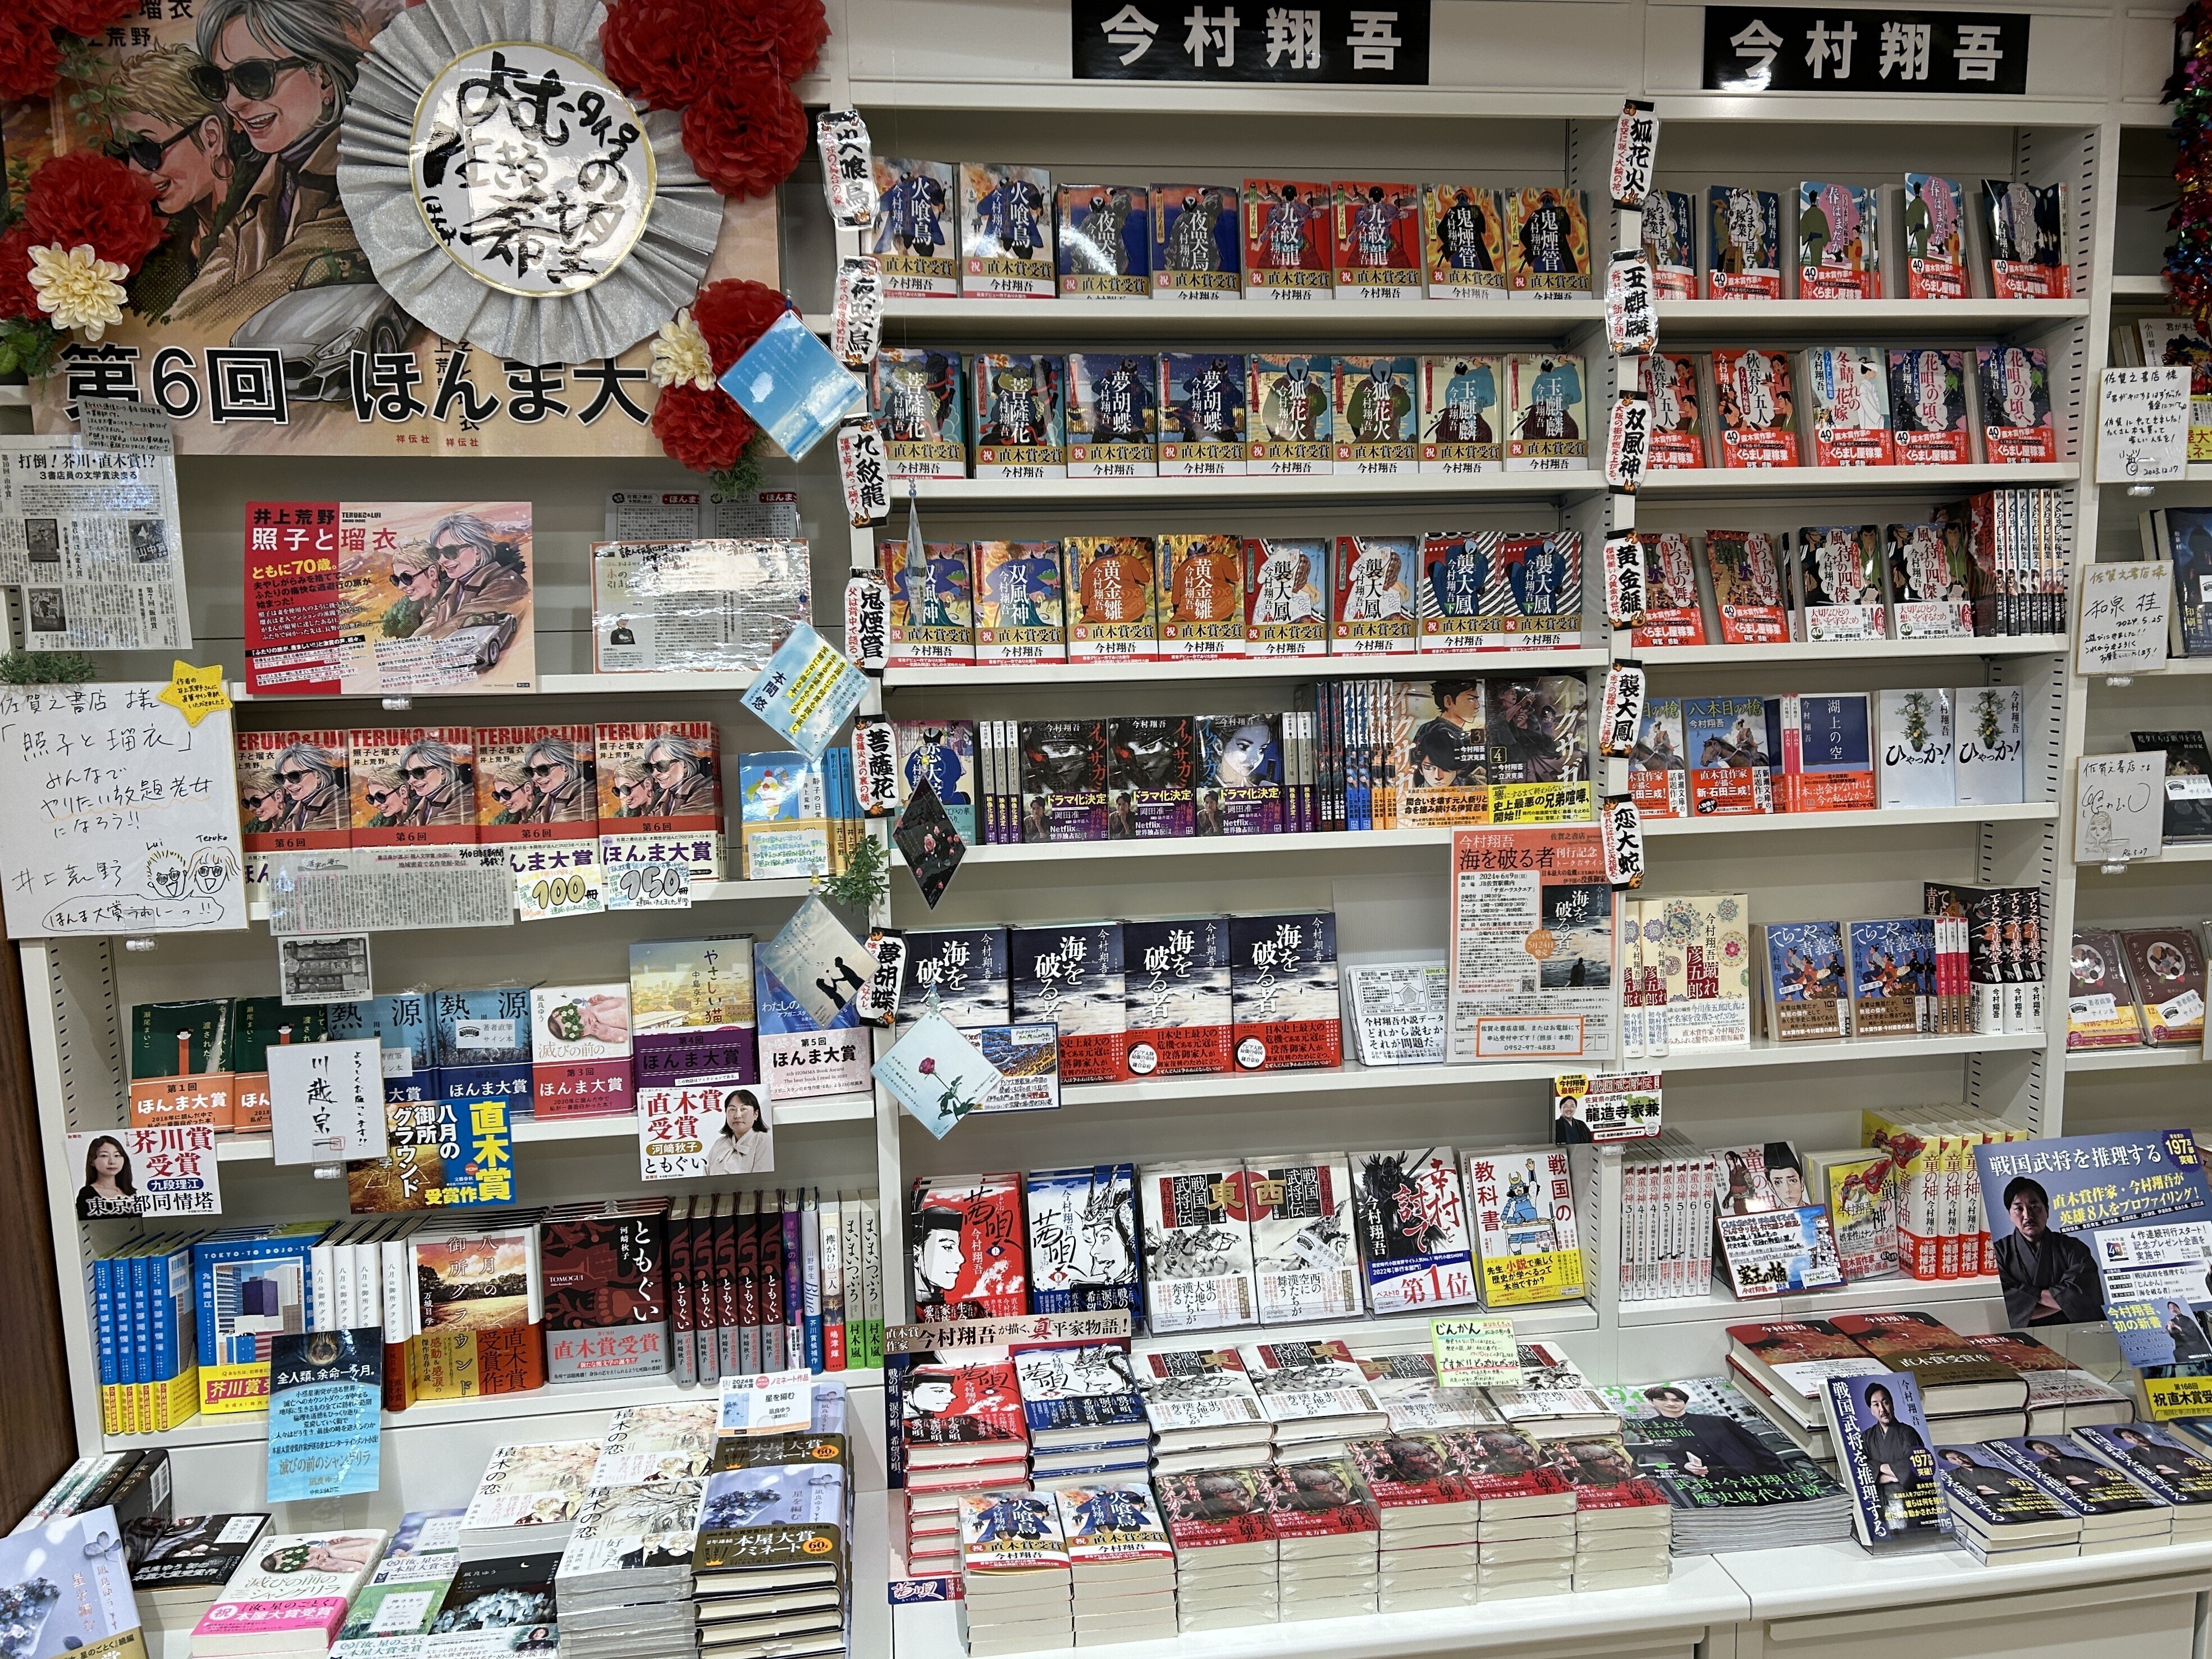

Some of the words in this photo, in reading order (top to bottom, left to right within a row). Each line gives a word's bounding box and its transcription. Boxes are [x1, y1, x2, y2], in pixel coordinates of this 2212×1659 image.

[1100, 4, 1402, 71] 今村翔吾
[1730, 19, 2003, 81] 今村翔吾
[1623, 118, 1653, 193] 狐花火
[911, 177, 931, 246] 火喰鳥
[1011, 181, 1030, 248] 火喰鳥
[1826, 185, 1844, 253] 春はまだか
[1280, 203, 1300, 266] 九紋龍
[1457, 207, 1477, 268] 鬼煙管
[987, 260, 1052, 279] 直木賞受賞
[990, 279, 1034, 292] 今村翔吾
[1358, 270, 1419, 285] 直木賞受賞
[1623, 267, 1651, 338] 玉麒麟
[58, 342, 289, 426] 第6回
[349, 349, 651, 427] ほんま大
[1745, 353, 1771, 424] 秋暮の五人
[1921, 354, 1945, 427] 花唄の頃へ
[1009, 378, 1030, 444] 菩薩花
[1112, 371, 1132, 433] 夢胡蝶
[1287, 380, 1307, 441] 狐花火
[1545, 377, 1565, 437] 玉麒麟
[1528, 441, 1585, 456] 直木賞受賞
[1619, 408, 1647, 479] 双風神
[1737, 448, 1789, 461] くらまし屋稼業
[1002, 465, 1044, 478] 今村翔吾
[253, 509, 335, 525] 井上荒野
[252, 527, 397, 552] 照子と瑠衣
[252, 558, 337, 579] ともに70歳。
[1616, 546, 1642, 615] 黄金雛
[1830, 531, 1853, 604] 風待ちの四傑
[1009, 564, 1030, 625] 双風神
[1194, 559, 1213, 619] 黄金雛
[1365, 559, 1383, 619] 襲大鳳
[859, 586, 885, 659] 鬼煙管
[1444, 635, 1483, 647] 今村翔吾
[1, 689, 108, 715] 佐賀之書店
[1688, 698, 1762, 718] 八本目の槍
[1827, 699, 1843, 761] 湖上の空
[353, 748, 400, 757] 照子と瑠衣
[353, 758, 386, 766] 井上荒野
[1959, 739, 2021, 765] ひゃっか!
[45, 767, 128, 789] みんなで
[803, 781, 811, 811] 井上荒野
[195, 833, 228, 843] Teruko
[396, 832, 427, 842] 第6回
[642, 821, 672, 832] 第6回
[1614, 808, 1641, 875] 恋大蛇
[1460, 849, 1556, 870] 海を破る者
[12, 860, 123, 894] 井上荒野
[1852, 922, 1899, 944] てらこや
[1168, 929, 1195, 979] 海を
[692, 971, 701, 1006] 中島京子
[703, 948, 724, 1024] やさしい猫
[872, 941, 902, 1011] 夢胡蝶
[1144, 946, 1172, 1019] 破る者
[1688, 947, 1703, 999] 彦五郎
[440, 991, 529, 1026] 熱源
[143, 1011, 151, 1049] 瀬尾まいこ
[483, 1035, 514, 1043] サイン本
[678, 1035, 704, 1046] 第4回
[801, 1036, 826, 1047] 第5回
[1369, 1037, 1441, 1049] それが問題だ。
[566, 1067, 595, 1077] 第3回
[642, 1049, 741, 1070] ほんま大賞
[773, 1044, 856, 1067] ほんま大賞
[167, 1082, 198, 1093] 第1回
[450, 1079, 527, 1097] ほんま大賞
[540, 1076, 623, 1095] ほんま大賞
[647, 1089, 724, 1116] 直木賞
[138, 1092, 228, 1115] ほんま大賞
[1585, 1103, 1660, 1122] 龍造寺家兼
[130, 1127, 213, 1155] 芥川賞
[415, 1105, 437, 1145] 御所
[437, 1104, 460, 1160] 八月の
[648, 1116, 698, 1142] 受賞
[147, 1152, 202, 1179] 受賞
[395, 1107, 419, 1199] グラウンド
[469, 1101, 512, 1202] 直木賞
[645, 1155, 708, 1174] ともぐい
[1989, 1143, 2161, 1177] 戦国武将を推理する
[150, 1179, 200, 1191] 九段理江
[1250, 1179, 1287, 1206] 西
[1548, 1155, 1573, 1222] 戦国の
[1921, 1154, 1940, 1201] 童の神
[2053, 1173, 2184, 1210] 直木賞作家・今村翔吾が
[87, 1191, 214, 1216] 東京都同情塔
[425, 1186, 477, 1206] 受賞作
[1207, 1180, 1244, 1210] 東
[1420, 1158, 1461, 1244] 幸村を
[1474, 1162, 1501, 1232] 教科書
[963, 1185, 1023, 1251] 茜唄
[204, 1249, 260, 1260] TOKYO-TO
[479, 1237, 497, 1296] 八月の
[632, 1221, 659, 1322] ともぐい
[844, 1219, 860, 1302] まいまいつぶろ
[549, 1275, 584, 1284] TOMOGUI
[1401, 1264, 1469, 1305] 第1位
[423, 1292, 433, 1326] 万城目学
[676, 1282, 690, 1329] ともぐい
[767, 1275, 780, 1322] ともぐい
[805, 1282, 819, 1314] Blue
[449, 1237, 472, 1396] 御所グラウンド
[1436, 1322, 1481, 1336] じんかん
[2113, 1316, 2162, 1332] 初の新書
[554, 1333, 660, 1361] 直木賞受賞
[830, 1331, 839, 1359] 嶋津輝
[850, 1324, 861, 1359] 村木嵐
[917, 1323, 996, 1349] 今村翔吾
[504, 1329, 527, 1391] 直木賞
[1898, 1354, 1991, 1367] 直木賞受賞作
[765, 1392, 796, 1403] 星を編む
[480, 1446, 518, 1496] 積木の恋
[1832, 1382, 1887, 1537] 戦国武将を推理する
[1673, 1468, 1820, 1491] 武将・今村翔吾と
[1012, 1499, 1038, 1534] 火喰鳥
[734, 1530, 816, 1547] 本屋大賞
[735, 1544, 802, 1558] ノミネート
